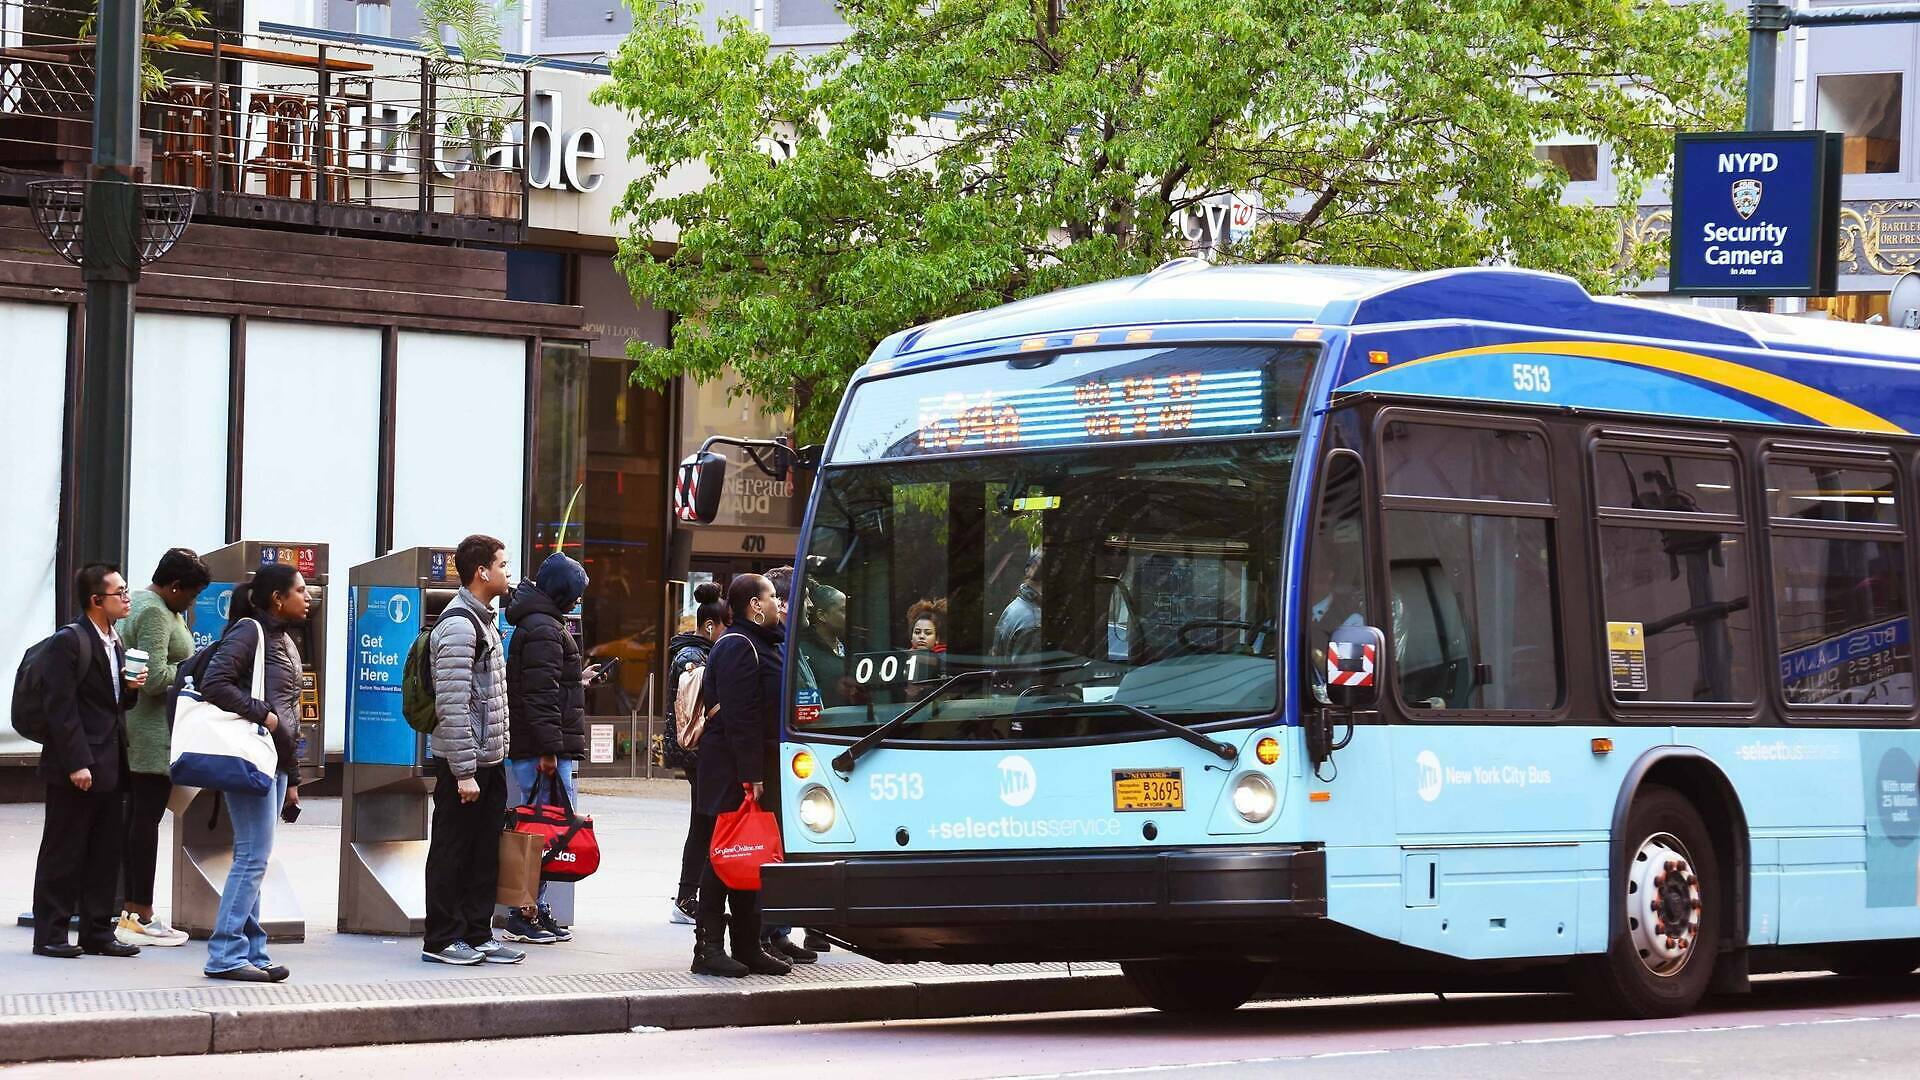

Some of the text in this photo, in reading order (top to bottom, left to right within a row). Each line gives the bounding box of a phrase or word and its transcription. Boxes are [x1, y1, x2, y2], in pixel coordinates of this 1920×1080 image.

[1718, 152, 1778, 173] NYPD
[1703, 221, 1788, 247] Security
[1704, 245, 1784, 265] Camera
[1730, 267, 1757, 275] In Area
[1512, 363, 1551, 393] 5513
[742, 534, 766, 553] 470
[193, 631, 213, 646] Get
[361, 633, 384, 648] Get
[360, 651, 399, 666] Ticket
[360, 667, 389, 682] Here
[870, 772, 924, 801] 5513
[998, 763, 1033, 801] MTA
[1445, 765, 1551, 788] New York City Bus
[1882, 780, 1916, 792] With over
[1151, 781, 1180, 801] 3695
